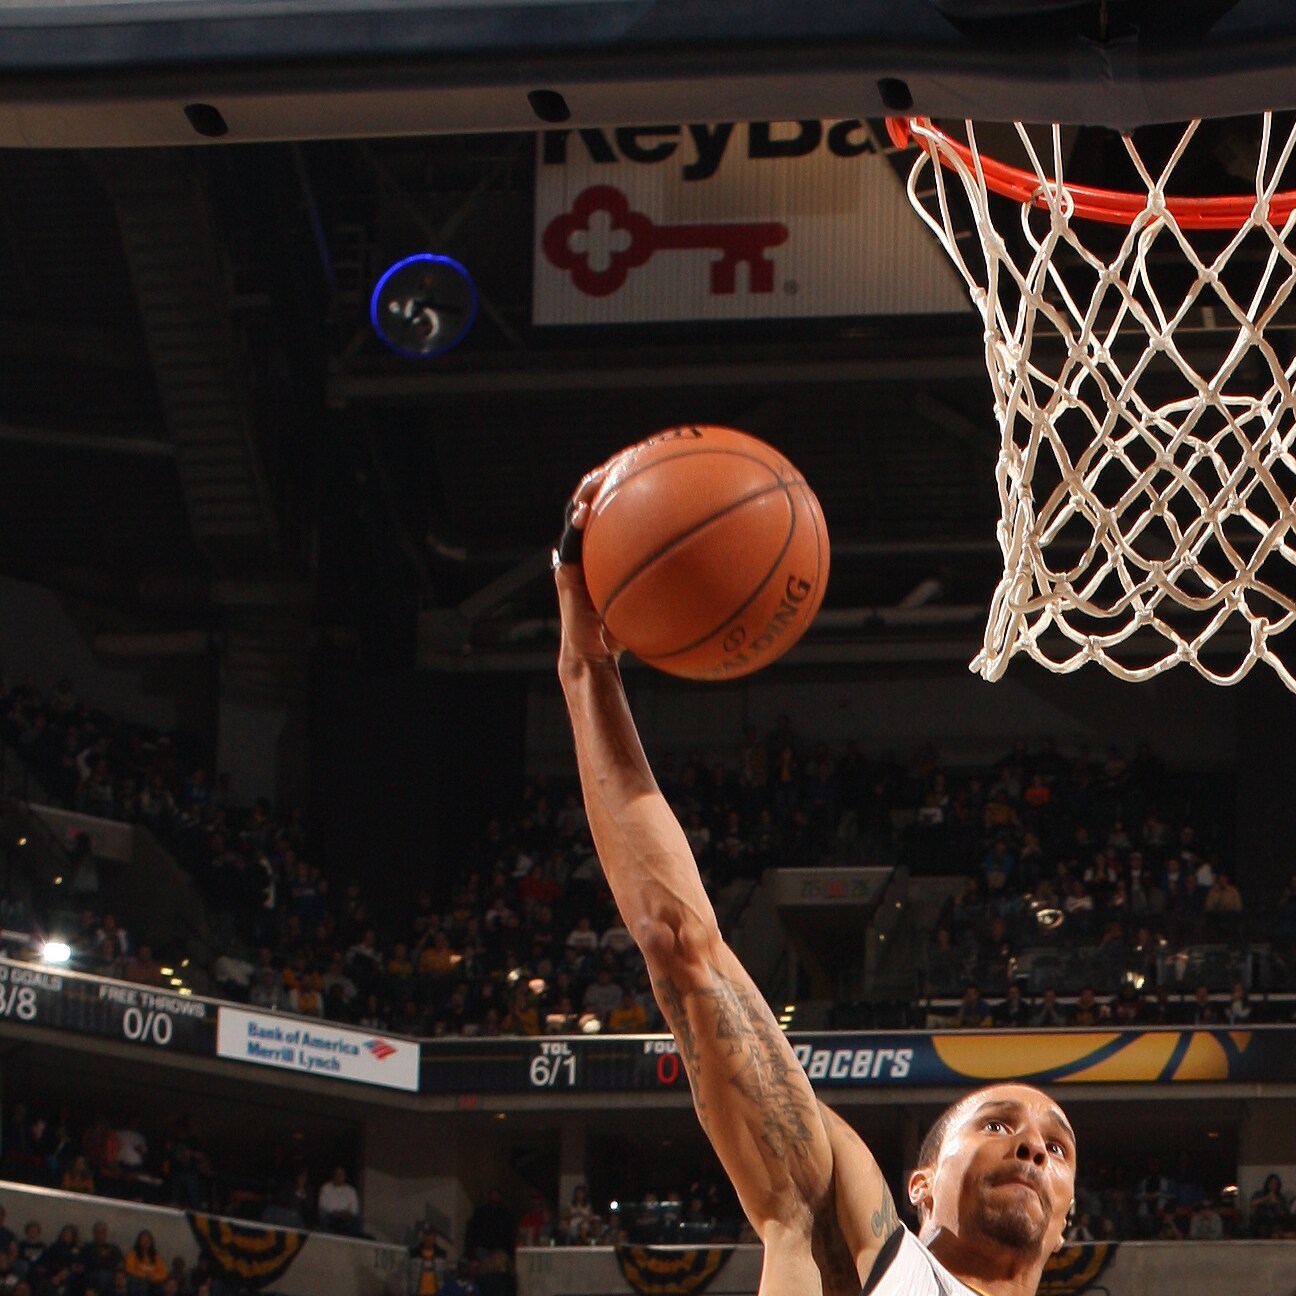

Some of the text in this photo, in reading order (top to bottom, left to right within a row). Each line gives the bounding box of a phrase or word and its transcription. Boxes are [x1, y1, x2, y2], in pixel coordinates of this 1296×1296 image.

[99, 985, 206, 1018] FREE THROWS
[123, 1007, 174, 1046] 0/0
[247, 1021, 361, 1057] Bank of America
[247, 1041, 341, 1074] Merrill Lynch
[530, 1056, 578, 1086] 6/1
